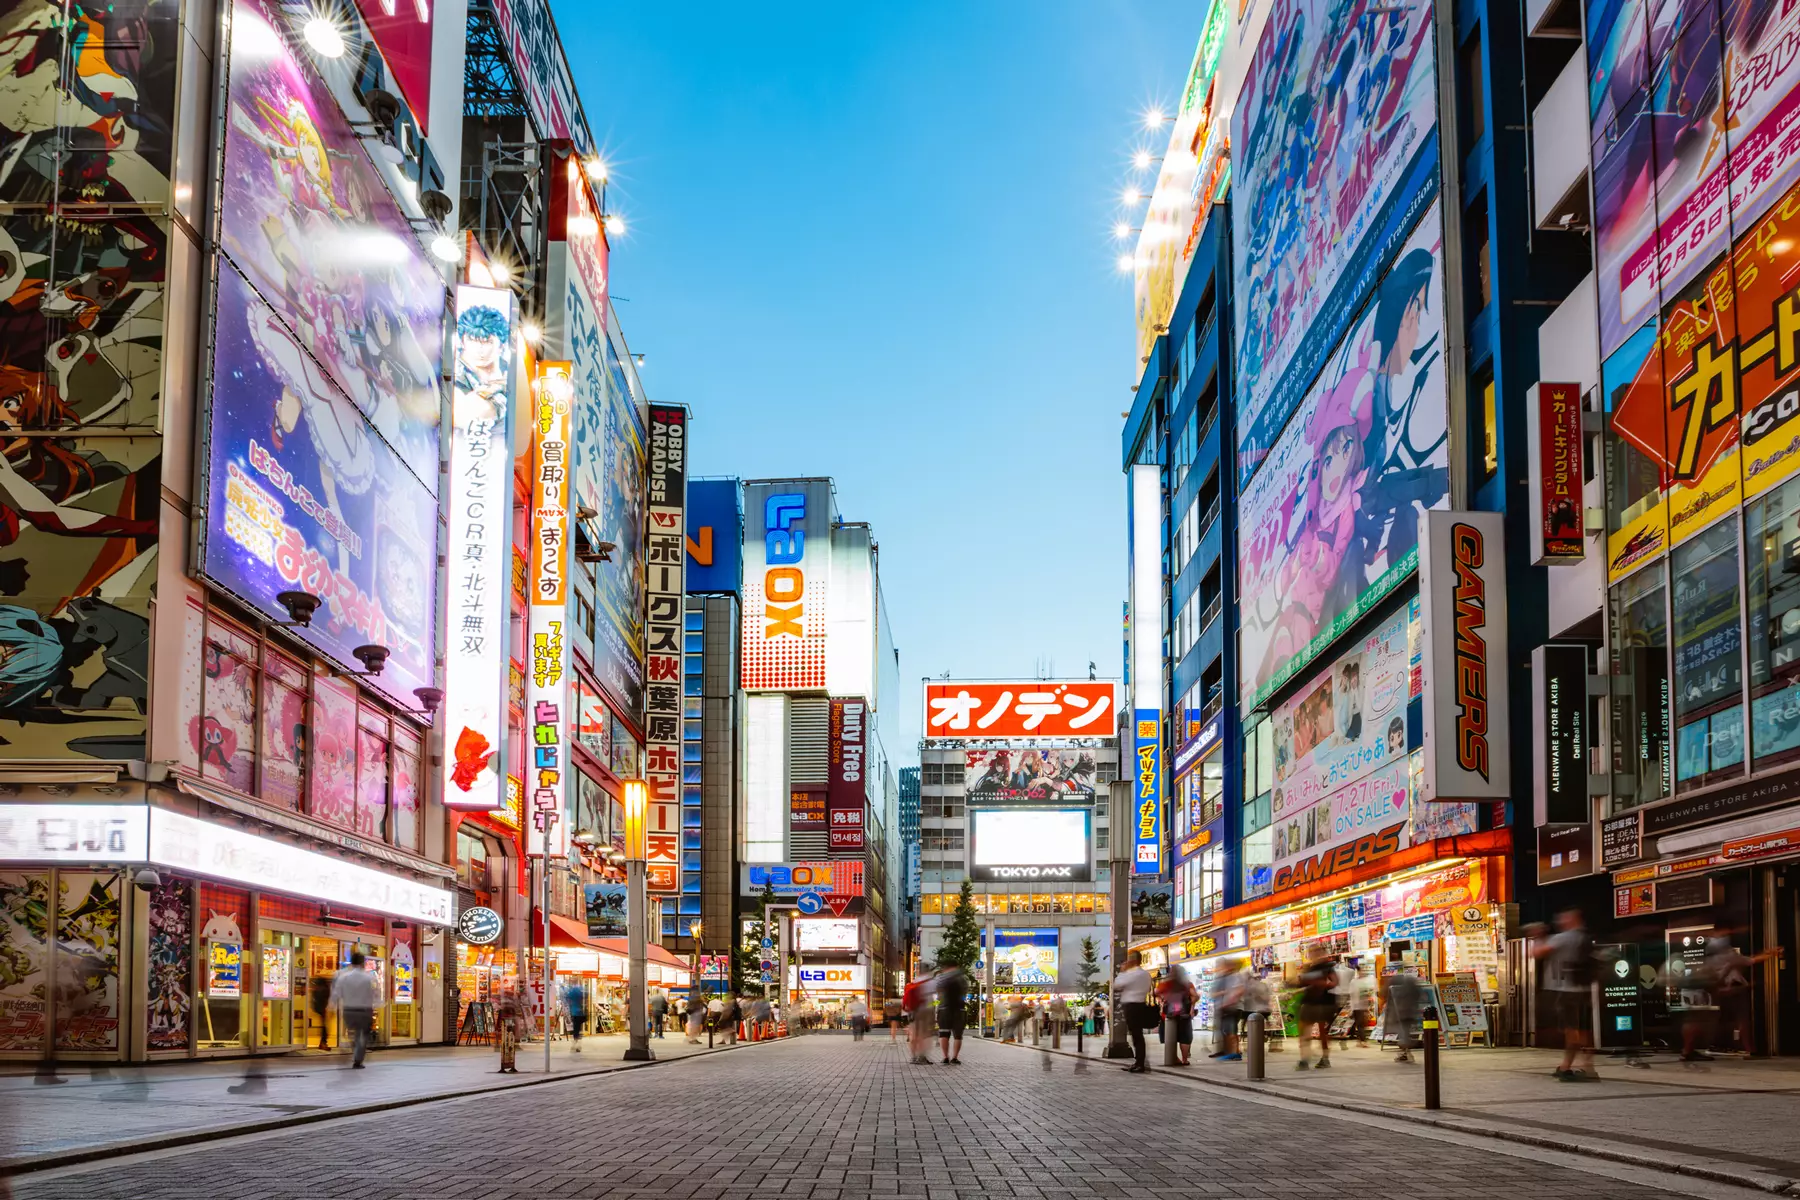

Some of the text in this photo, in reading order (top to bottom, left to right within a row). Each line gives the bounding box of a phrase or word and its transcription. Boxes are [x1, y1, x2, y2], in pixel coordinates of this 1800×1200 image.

[1385, 178, 1435, 250] Transition
[541, 440, 564, 499] 買取り
[651, 411, 668, 503] PARADISE
[667, 411, 684, 474] HOBBY
[1552, 402, 1569, 496] カードキングダム
[249, 438, 363, 560] ぱちんこで登場!!
[540, 527, 561, 597] まっくす
[534, 633, 551, 689] 買います
[548, 621, 563, 686] フィギュア
[1451, 522, 1490, 785] GAMERS
[833, 703, 842, 764] Flagship Store
[930, 684, 1111, 731] オノデン
[1138, 721, 1157, 738] 薬
[1550, 677, 1560, 793] ALIENWARE STORE AKIBA
[1573, 724, 1581, 742] Real
[842, 703, 863, 782] Duty Free
[1573, 742, 1581, 759] Dell
[833, 812, 861, 824] 免税
[1137, 744, 1158, 839] マツモトキヨシ
[1335, 816, 1353, 835] ON
[1356, 795, 1392, 828] SALE
[1655, 783, 1788, 823] ALIENWARE STORE AKIBA
[832, 833, 861, 843] 면세점
[1273, 820, 1408, 893] GAMERS
[990, 866, 1072, 877] TOKYO MX
[462, 929, 496, 942] VAPE STAND
[463, 907, 496, 922] SMOKER'S
[1012, 903, 1069, 913] MODIFY
